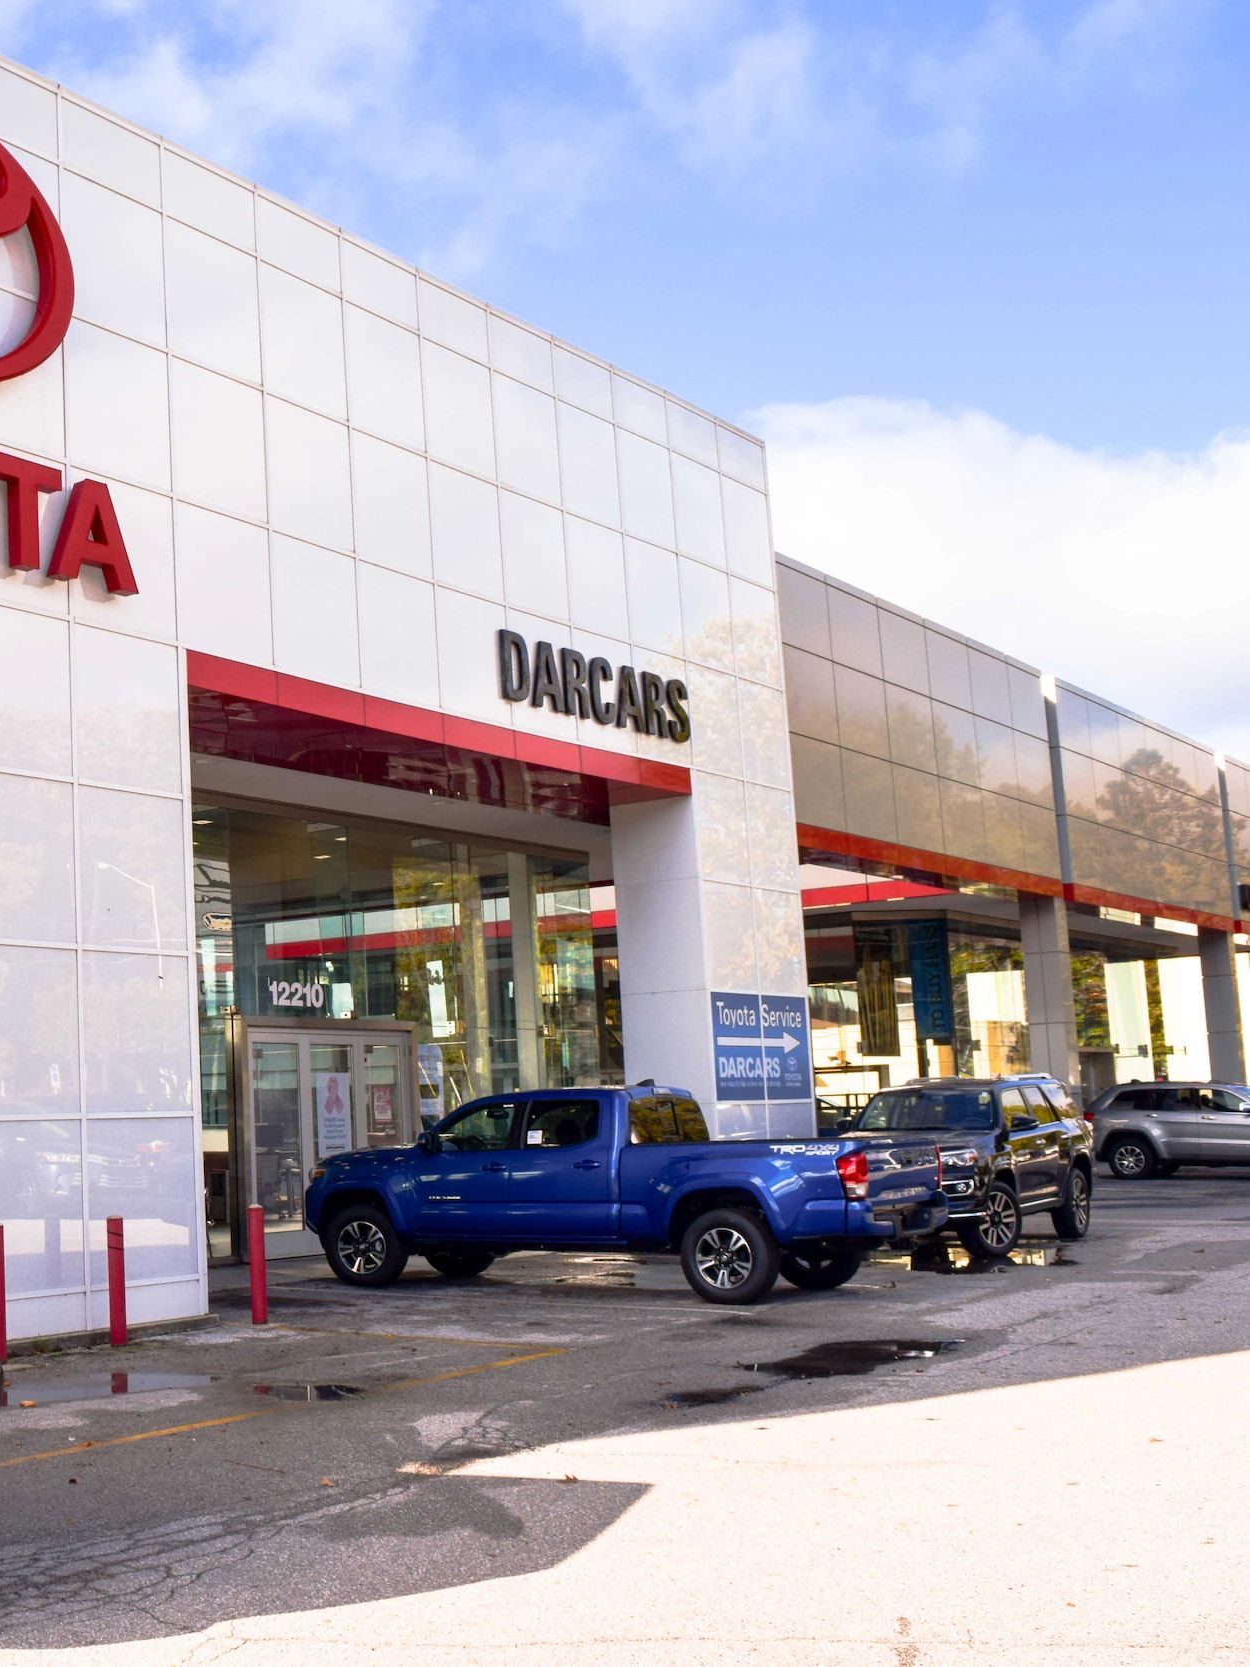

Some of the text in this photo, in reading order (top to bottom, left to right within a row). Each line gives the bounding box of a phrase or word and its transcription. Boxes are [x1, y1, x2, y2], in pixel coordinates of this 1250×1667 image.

[498, 628, 691, 744] DARCARS
[268, 980, 325, 1009] 12210
[715, 1000, 802, 1029] Toyota Service
[718, 1056, 781, 1079] DARCARS
[770, 1144, 806, 1155] TRD
